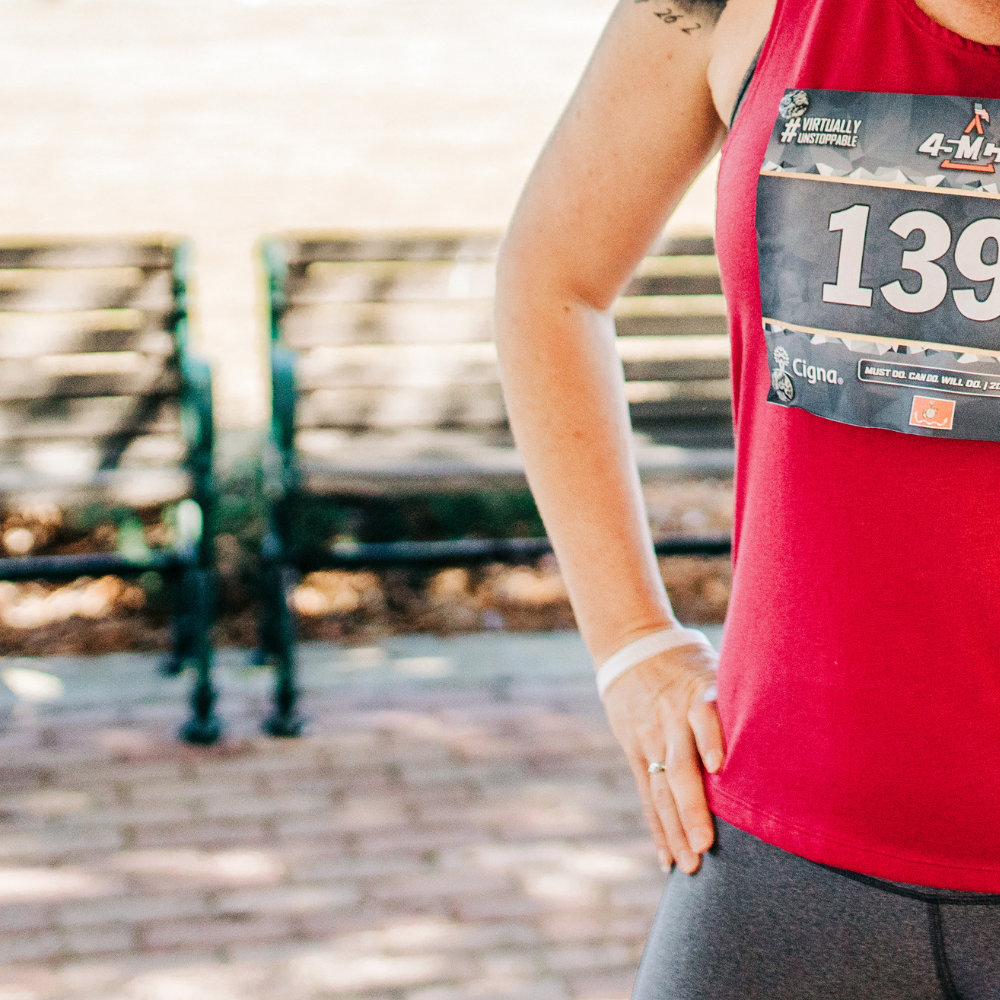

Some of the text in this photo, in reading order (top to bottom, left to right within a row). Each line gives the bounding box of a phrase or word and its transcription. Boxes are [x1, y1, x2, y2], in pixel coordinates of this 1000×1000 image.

[802, 117, 862, 134] VIRTUALLY
[796, 132, 859, 147] UNSTOPPABLE
[864, 366, 891, 378] MUST
[891, 369, 907, 379] DO.
[908, 371, 926, 382] CAN
[925, 373, 940, 384] DO.
[941, 375, 964, 387] WILL
[965, 379, 982, 389] DO.
